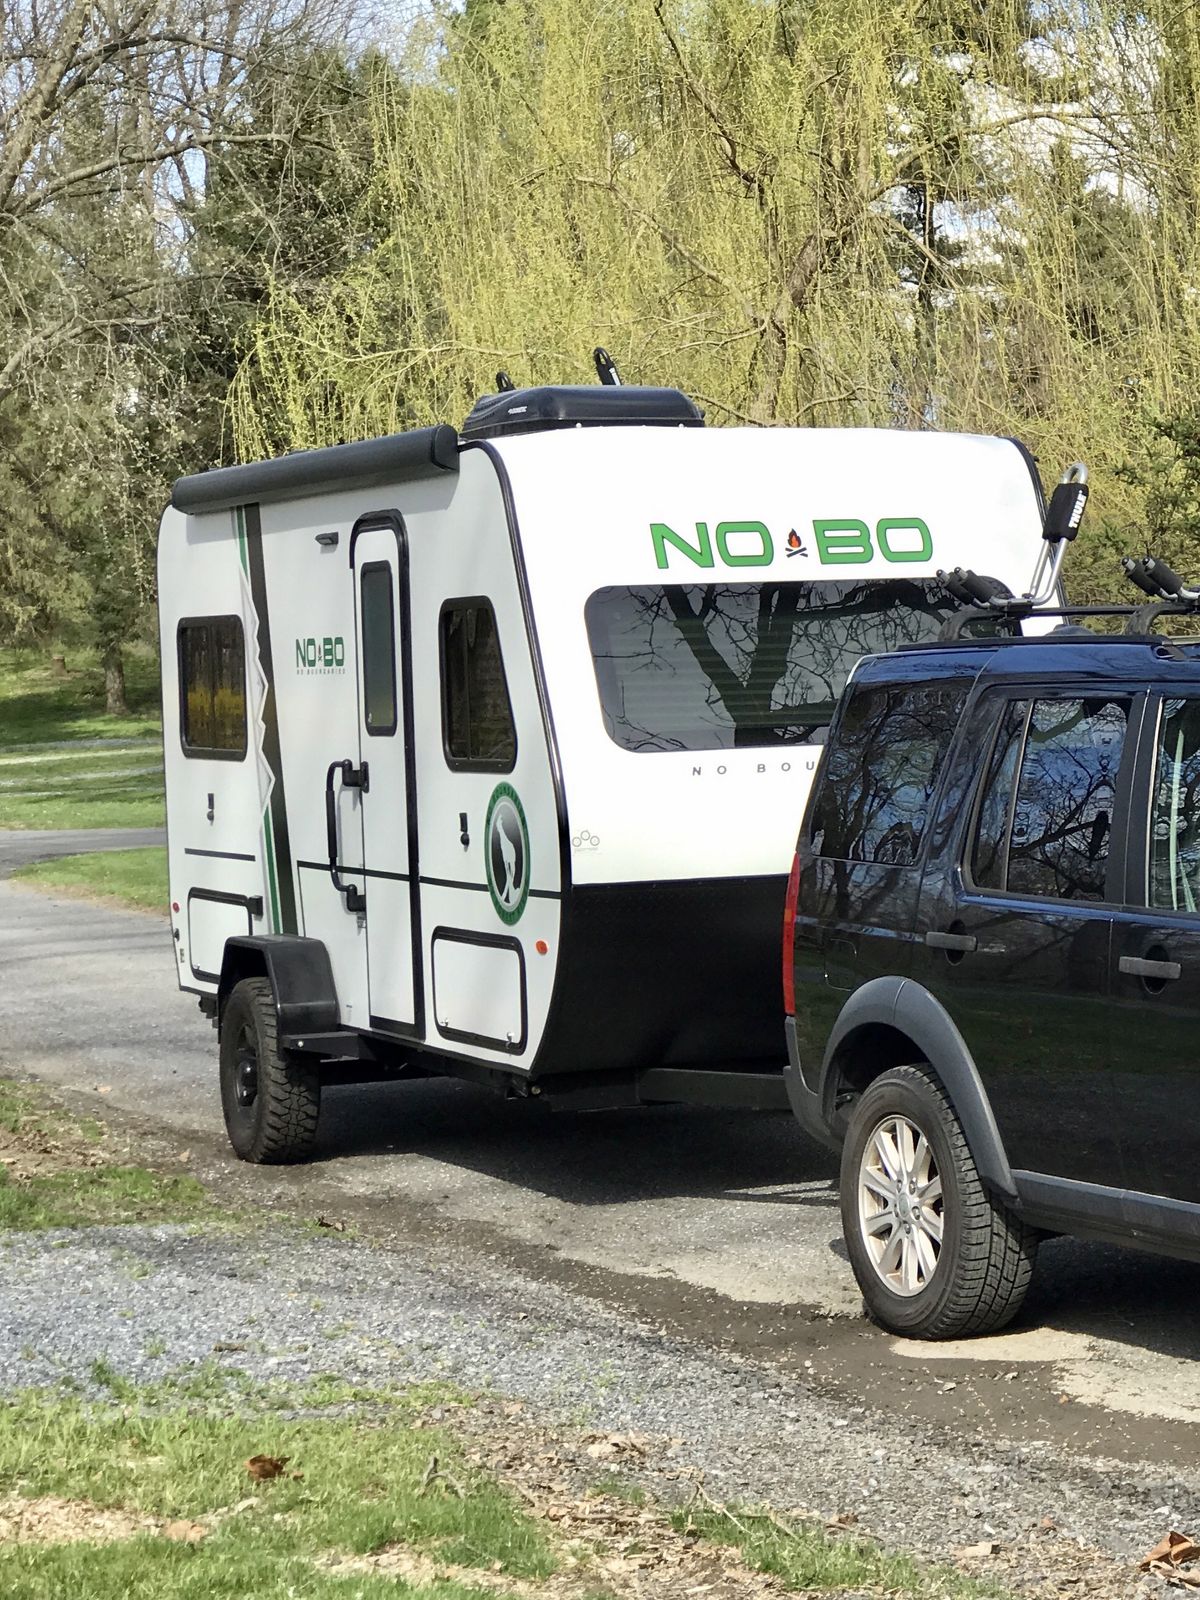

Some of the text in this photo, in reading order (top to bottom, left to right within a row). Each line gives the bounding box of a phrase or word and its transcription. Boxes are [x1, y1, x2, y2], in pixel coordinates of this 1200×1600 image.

[1068, 492, 1088, 529] THULE
[649, 517, 933, 569] NO BO
[295, 636, 345, 668] NO BO
[692, 765, 727, 776] NO
